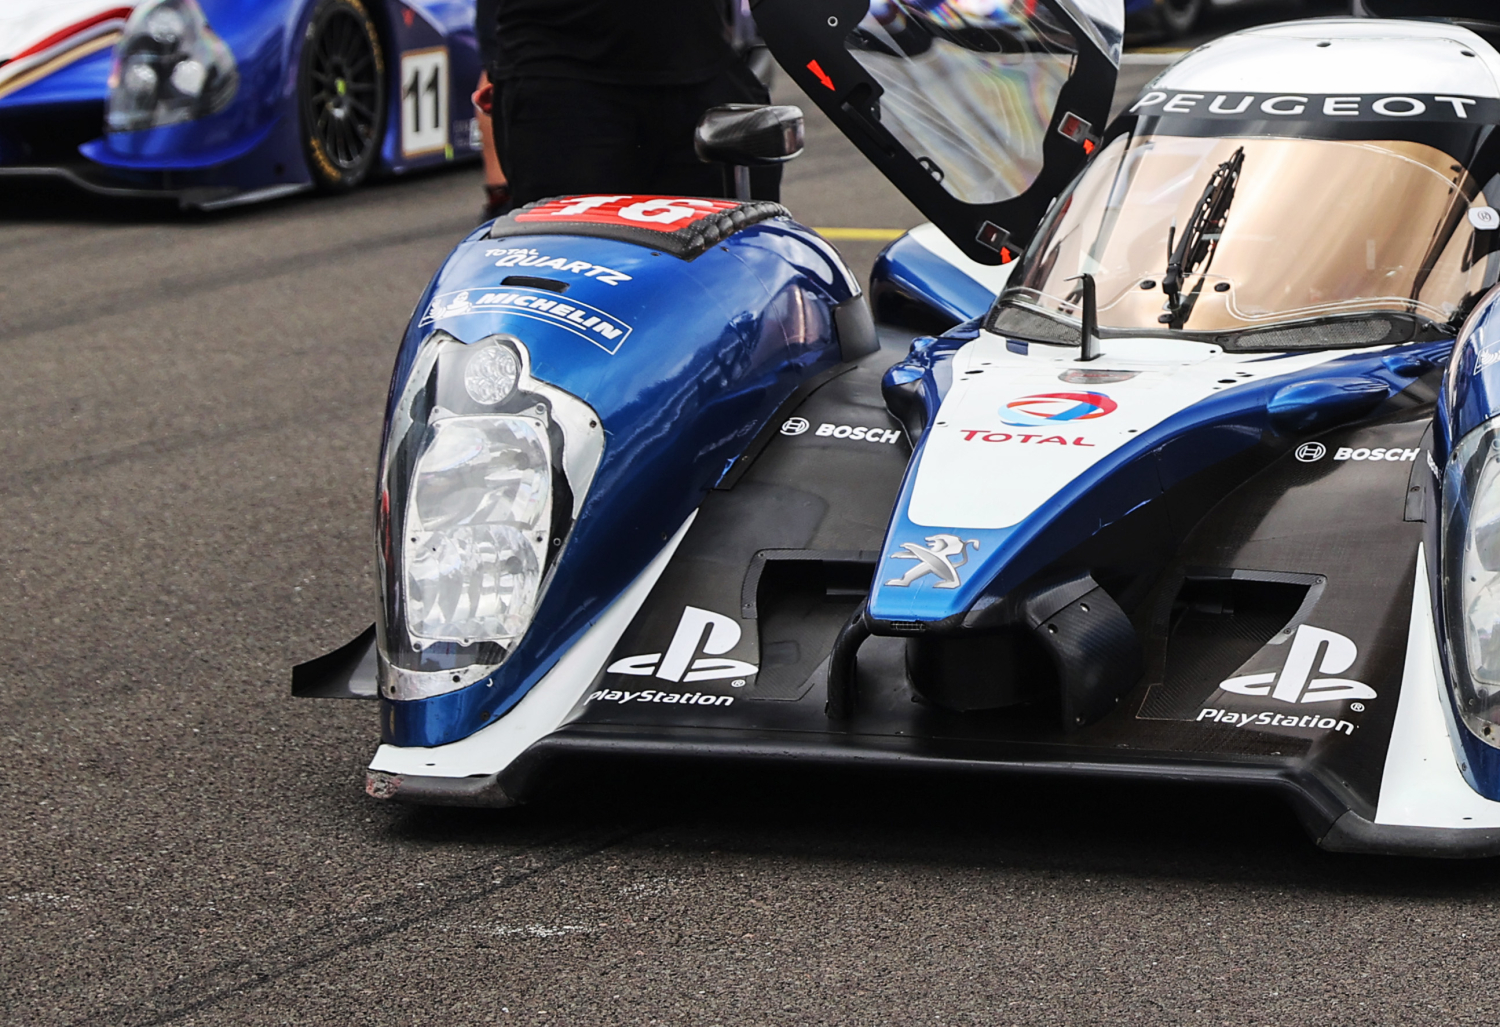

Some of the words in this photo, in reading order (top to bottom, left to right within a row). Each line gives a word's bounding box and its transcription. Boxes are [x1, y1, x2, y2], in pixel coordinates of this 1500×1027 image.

[402, 63, 441, 133] 11
[1129, 90, 1477, 119] PEUGEOT
[485, 248, 540, 258] TOTAL
[494, 253, 633, 286] QUARTZ
[475, 292, 623, 340] MICHELIN
[815, 423, 902, 445] BOSCH
[960, 429, 1096, 447] TOTAL
[1333, 447, 1421, 462] BOSCH
[1195, 708, 1358, 736] PlayStation
